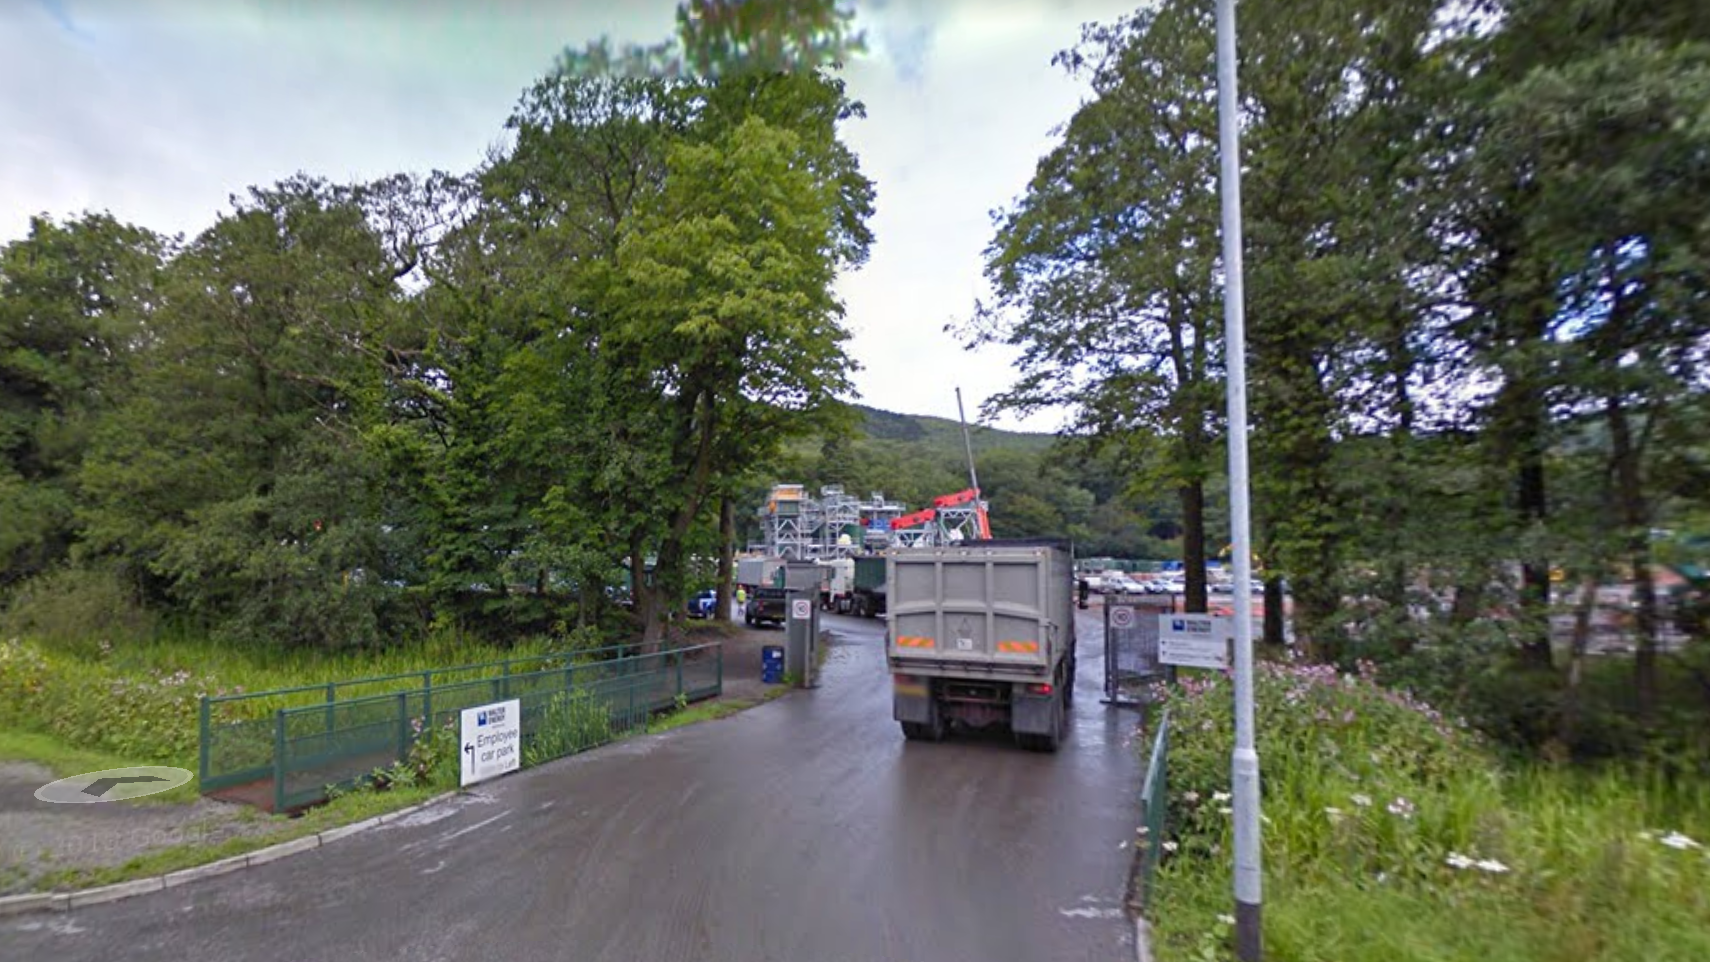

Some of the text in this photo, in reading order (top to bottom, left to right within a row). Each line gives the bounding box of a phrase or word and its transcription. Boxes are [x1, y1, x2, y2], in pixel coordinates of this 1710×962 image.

[477, 729, 518, 748] Employee
[481, 744, 514, 762] car park
